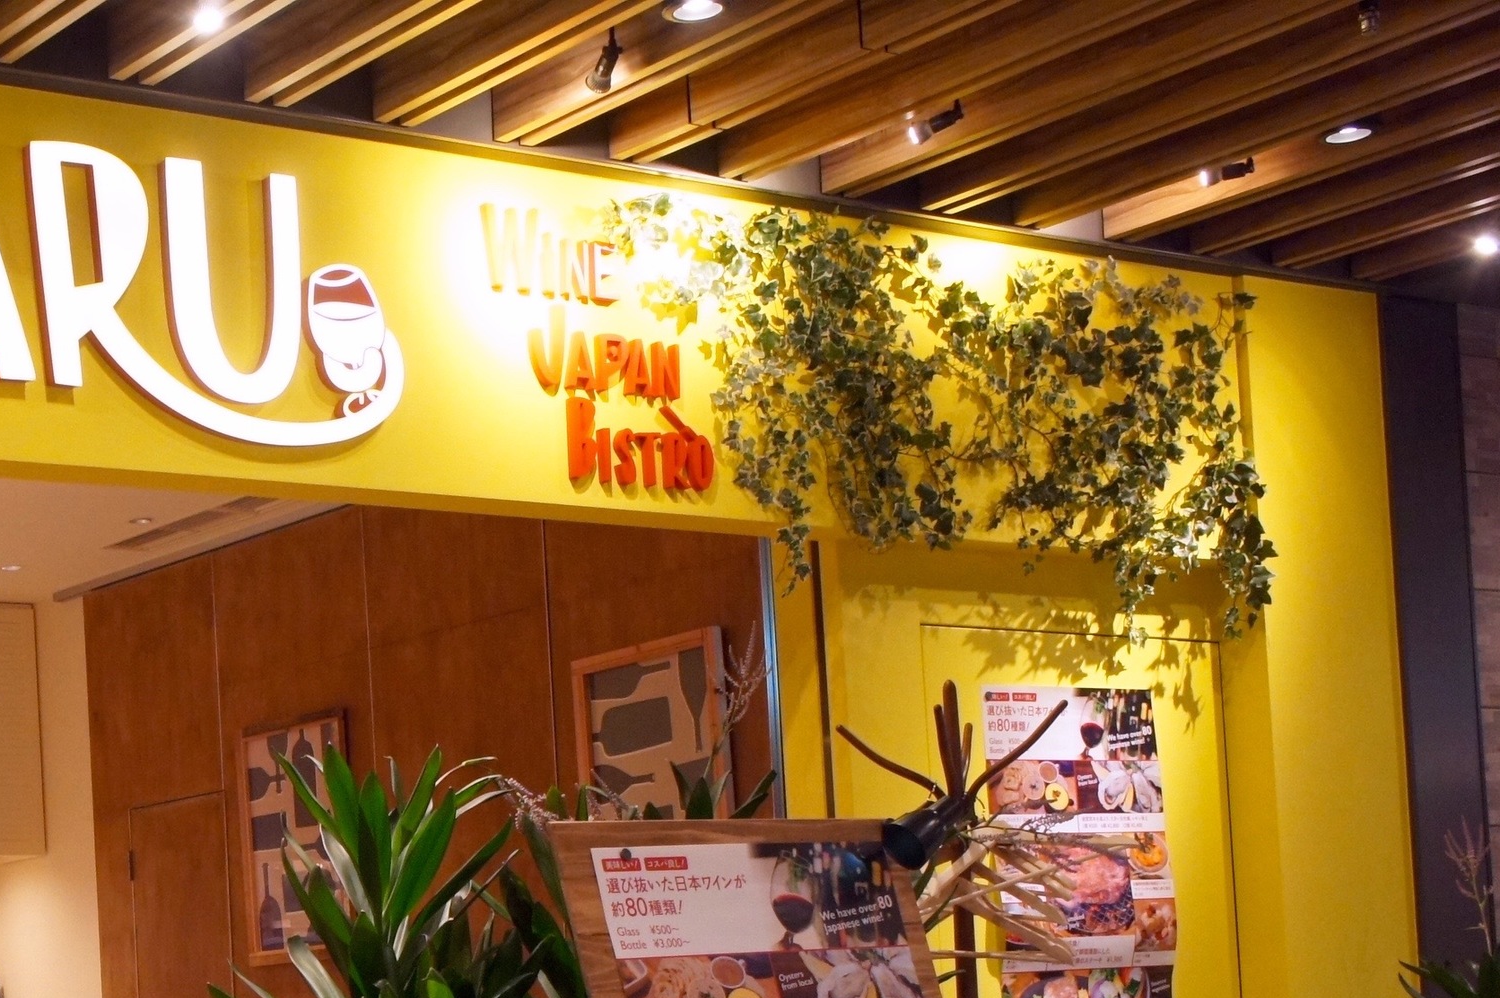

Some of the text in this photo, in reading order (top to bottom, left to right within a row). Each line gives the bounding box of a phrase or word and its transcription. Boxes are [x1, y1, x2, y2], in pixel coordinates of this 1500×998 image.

[527, 305, 680, 400] JAPAN
[606, 873, 747, 894] 選び抜いた日本ワインが
[611, 897, 683, 918] 約80種類!
[820, 894, 893, 921] We have over 80
[616, 926, 640, 937] Glass
[824, 911, 885, 936] Japanese wine!
[620, 939, 648, 950] Bottle
[779, 971, 804, 983] Oysters
[781, 977, 814, 991] from local
